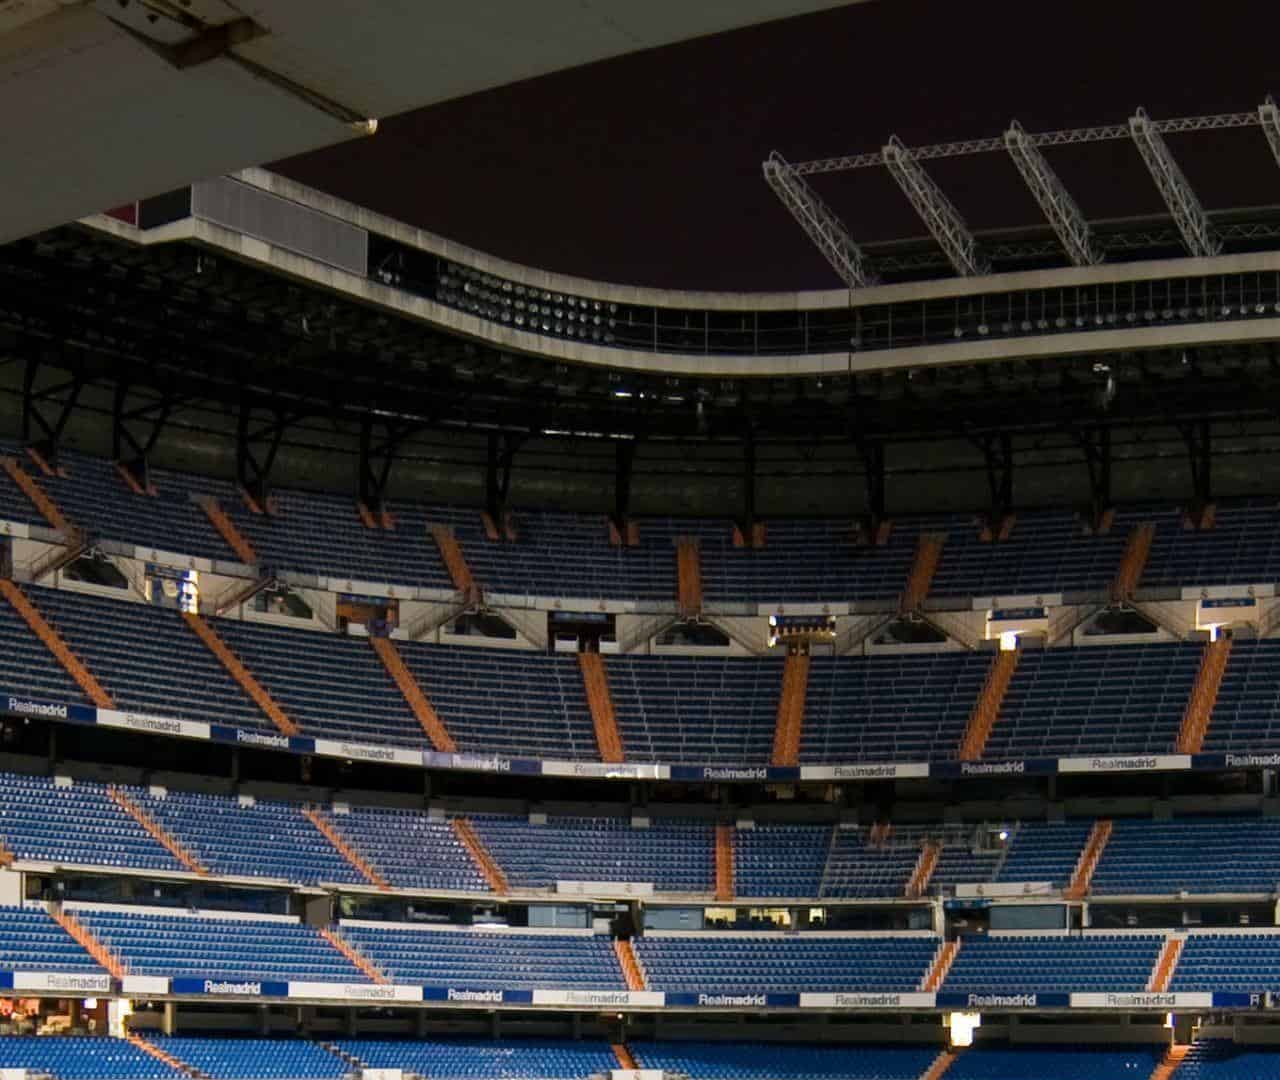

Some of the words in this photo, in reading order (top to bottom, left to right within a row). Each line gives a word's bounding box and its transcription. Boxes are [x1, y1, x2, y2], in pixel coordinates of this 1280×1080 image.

[8, 698, 68, 718] Realmadrid
[126, 715, 181, 734] Realmadrid
[236, 729, 289, 747] Realmadrid
[451, 752, 510, 771] Rlmadrid
[961, 761, 1024, 774] Realmadrid
[1092, 757, 1157, 770] Realmadrid
[703, 767, 767, 780] Realmadrid
[834, 766, 897, 778] Realmadrid
[47, 976, 108, 989] Realmadrid
[204, 981, 261, 995] Realmadrid
[447, 989, 503, 1002] Realmadrid
[698, 994, 766, 1006] Realmadrid
[834, 994, 900, 1006] Realmadrid
[967, 994, 1037, 1006] Realmadrid
[1106, 995, 1176, 1007] Realmadrid
